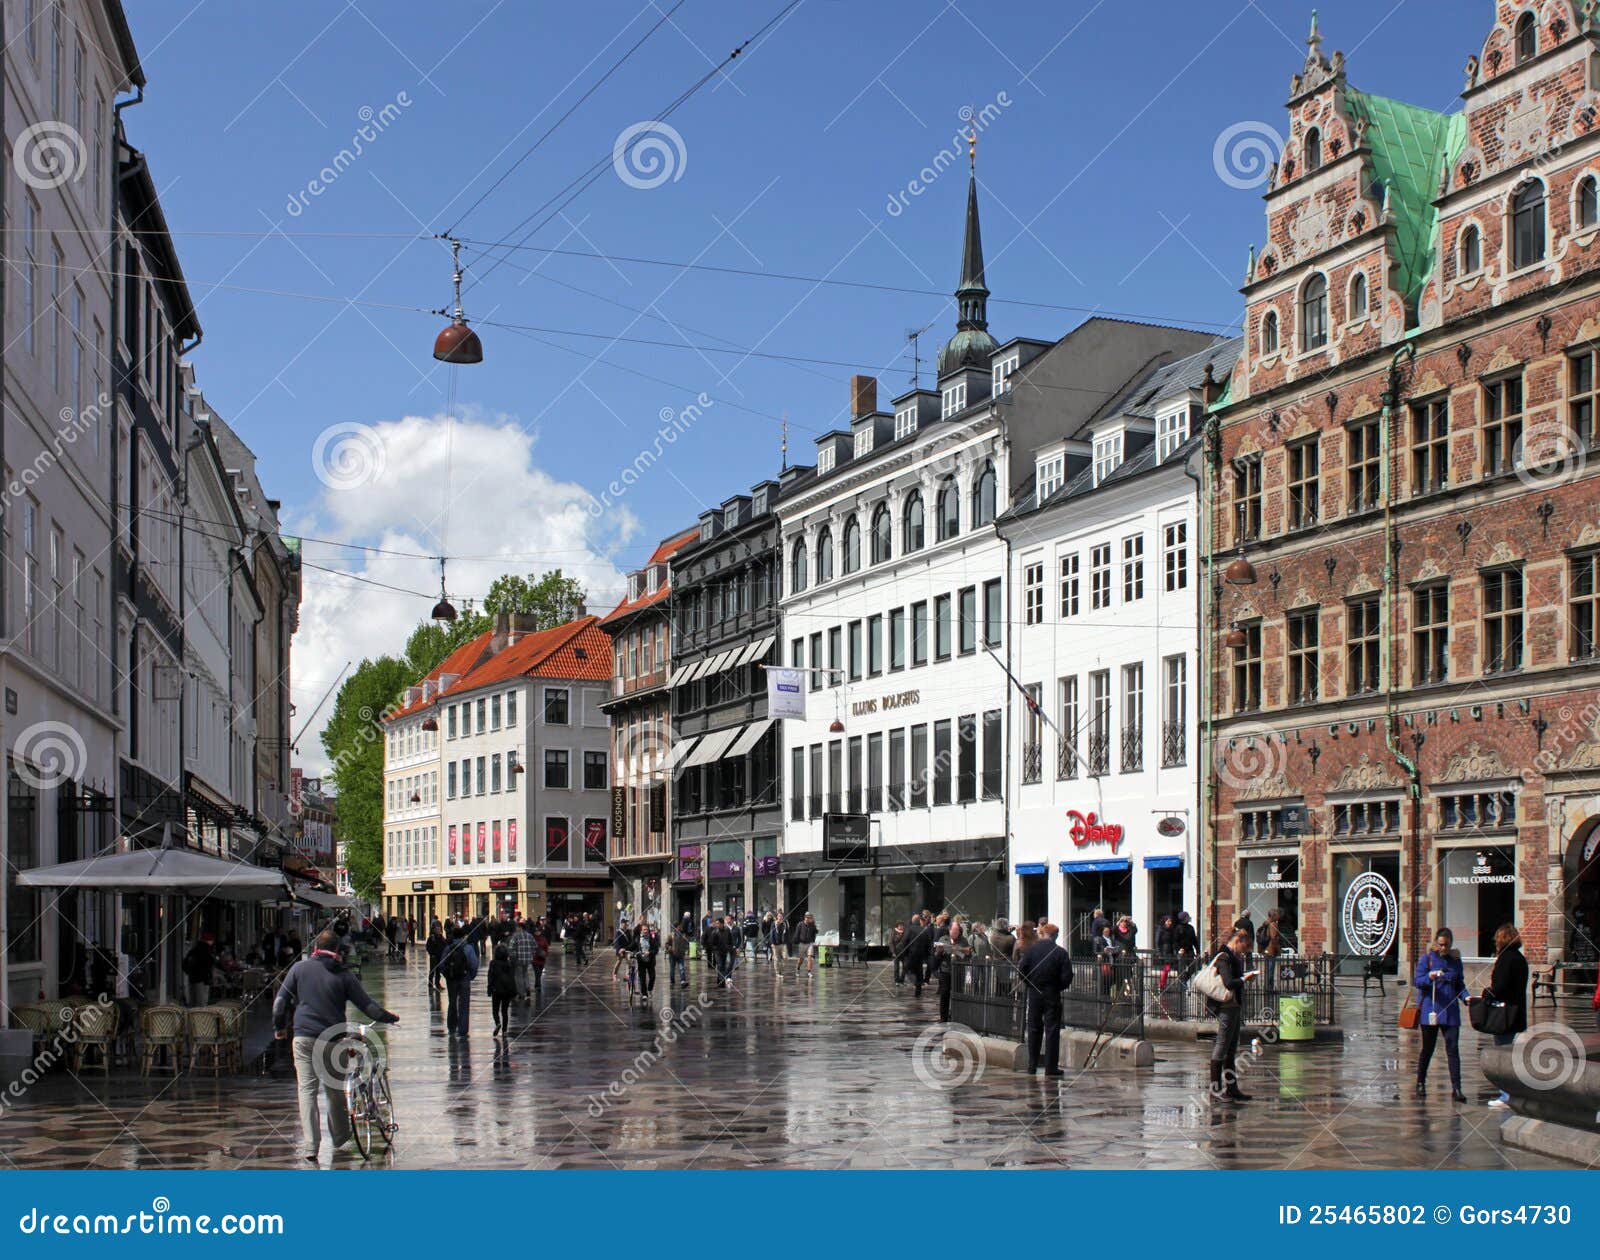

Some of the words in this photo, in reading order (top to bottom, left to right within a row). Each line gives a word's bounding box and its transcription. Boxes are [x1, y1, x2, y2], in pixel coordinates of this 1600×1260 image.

[852, 698, 878, 717] ILLUMS
[882, 689, 920, 711] BOLIGHUS
[615, 788, 623, 835] MONSOON
[1066, 810, 1122, 855] Disney
[1448, 876, 1470, 885] ROYAL
[1470, 874, 1516, 884] COPENHAGEN
